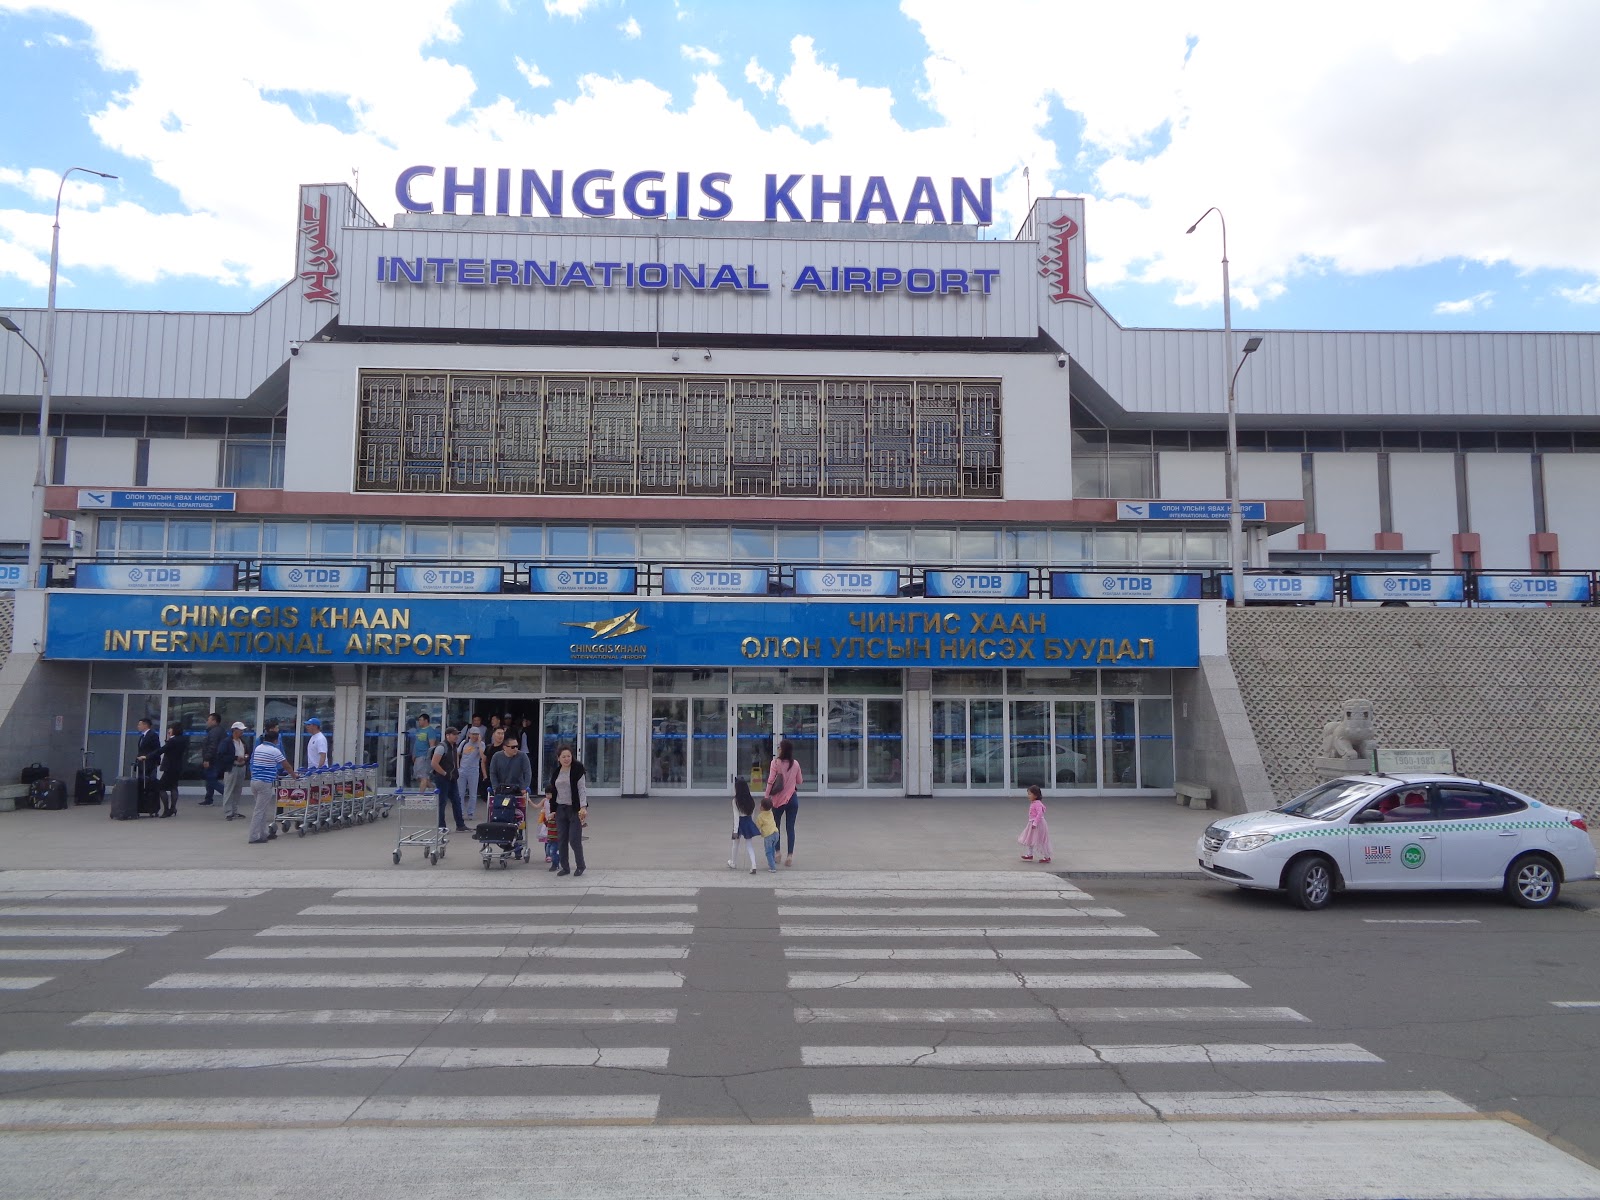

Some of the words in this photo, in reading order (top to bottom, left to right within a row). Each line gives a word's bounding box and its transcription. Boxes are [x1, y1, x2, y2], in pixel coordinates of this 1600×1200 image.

[395, 164, 733, 221] CHINGGIS
[764, 173, 993, 226] KHAAN
[377, 256, 770, 292] INTERNATIONAL
[791, 265, 1000, 296] AIRPORT
[144, 568, 181, 582] TDB
[304, 569, 340, 583] TDB
[439, 570, 475, 584] TDB
[572, 571, 608, 585] TDB
[706, 572, 741, 586] TDB
[837, 573, 872, 587] TDB
[967, 575, 1002, 589] TDB
[1117, 577, 1152, 591] TDB
[1267, 578, 1302, 592] TDB
[1398, 578, 1431, 592] TDB
[1523, 579, 1557, 592] TDB
[160, 604, 299, 629] CHINGGIS
[311, 606, 410, 630] KHAAN
[849, 611, 962, 635] ЧИНГИС
[970, 612, 1047, 634] ХААН
[104, 629, 332, 655] INTERNATIONAL
[344, 632, 471, 656] AIRPORT
[570, 644, 613, 653] CHINGGIS
[614, 644, 647, 653] KHAAN
[740, 636, 821, 659] ОЛОН
[831, 637, 931, 660] УЛСЫН
[940, 637, 1036, 660] НИСЭХ
[1044, 637, 1155, 664] БУУДАЛ
